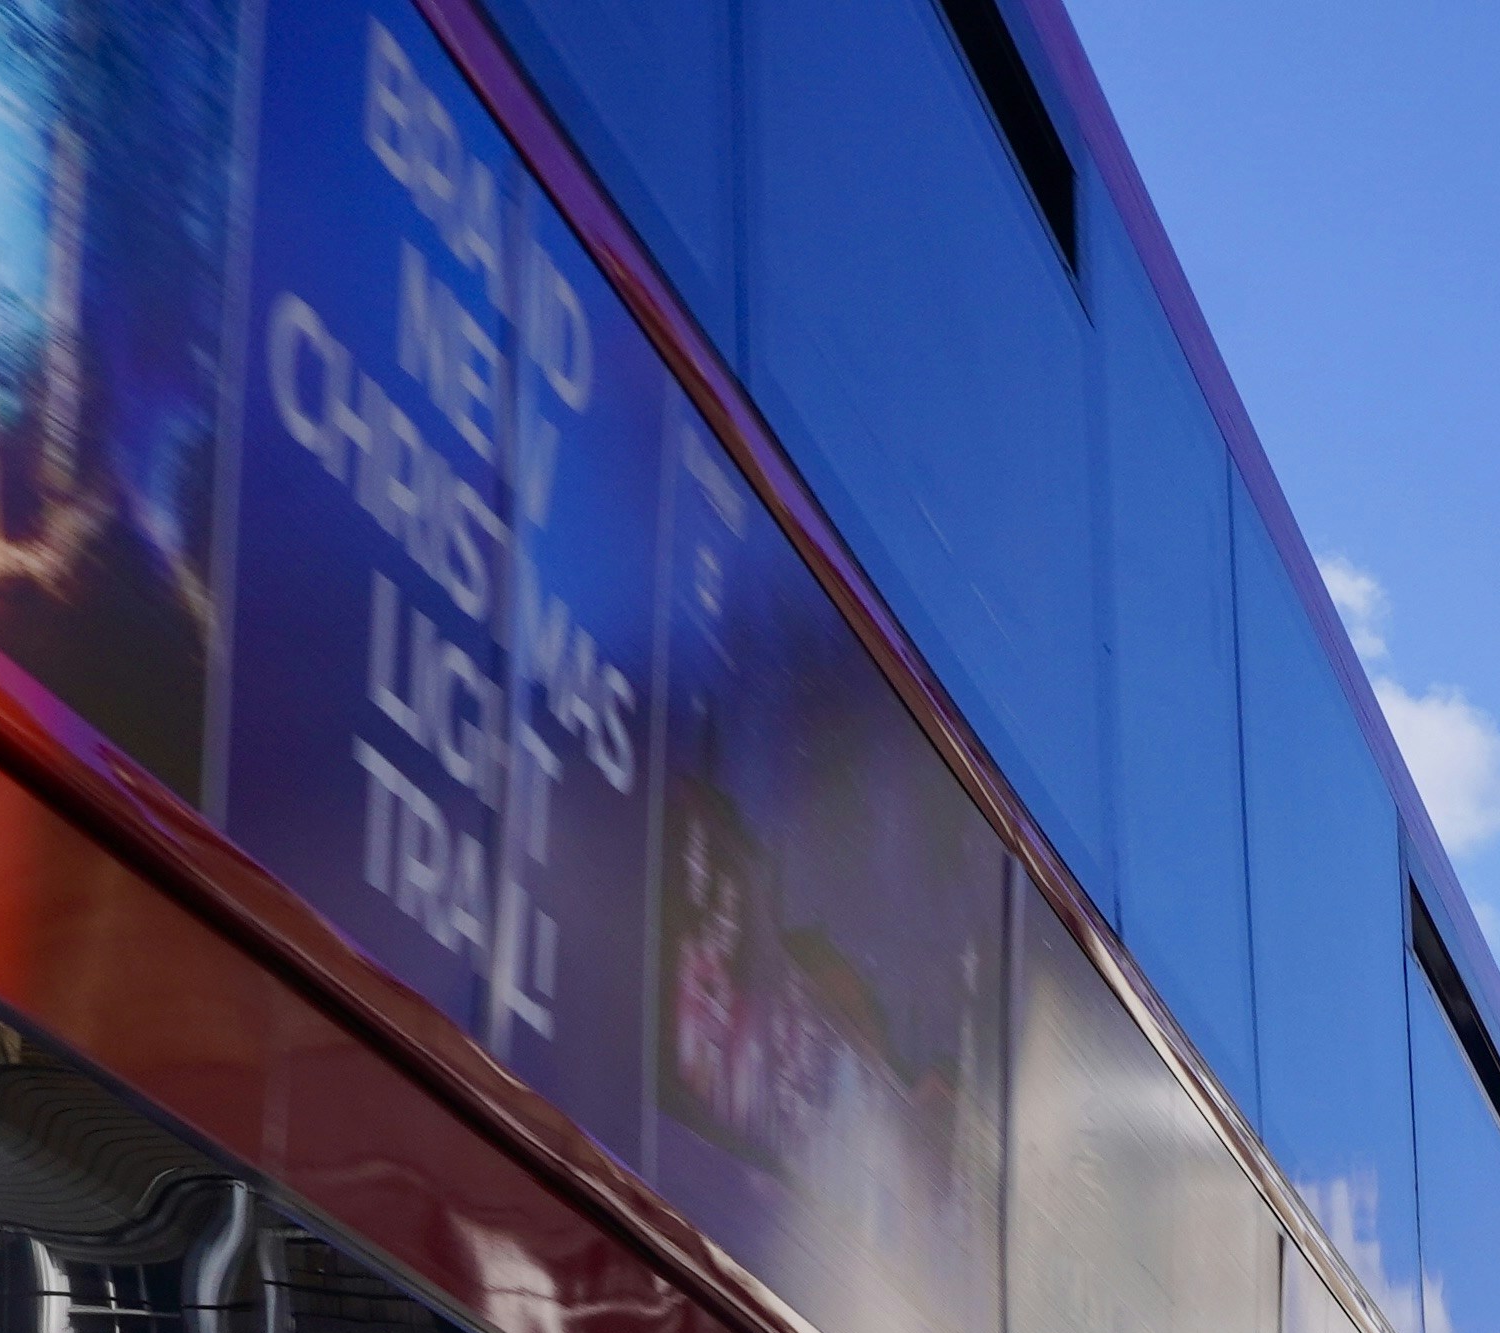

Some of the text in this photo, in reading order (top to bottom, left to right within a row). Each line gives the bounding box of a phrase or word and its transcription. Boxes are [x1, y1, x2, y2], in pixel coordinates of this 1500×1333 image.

[364, 14, 593, 414] BRAND
[399, 237, 561, 531] NEW
[267, 292, 635, 795] CHRISTMAS
[368, 568, 564, 867] LIGHT
